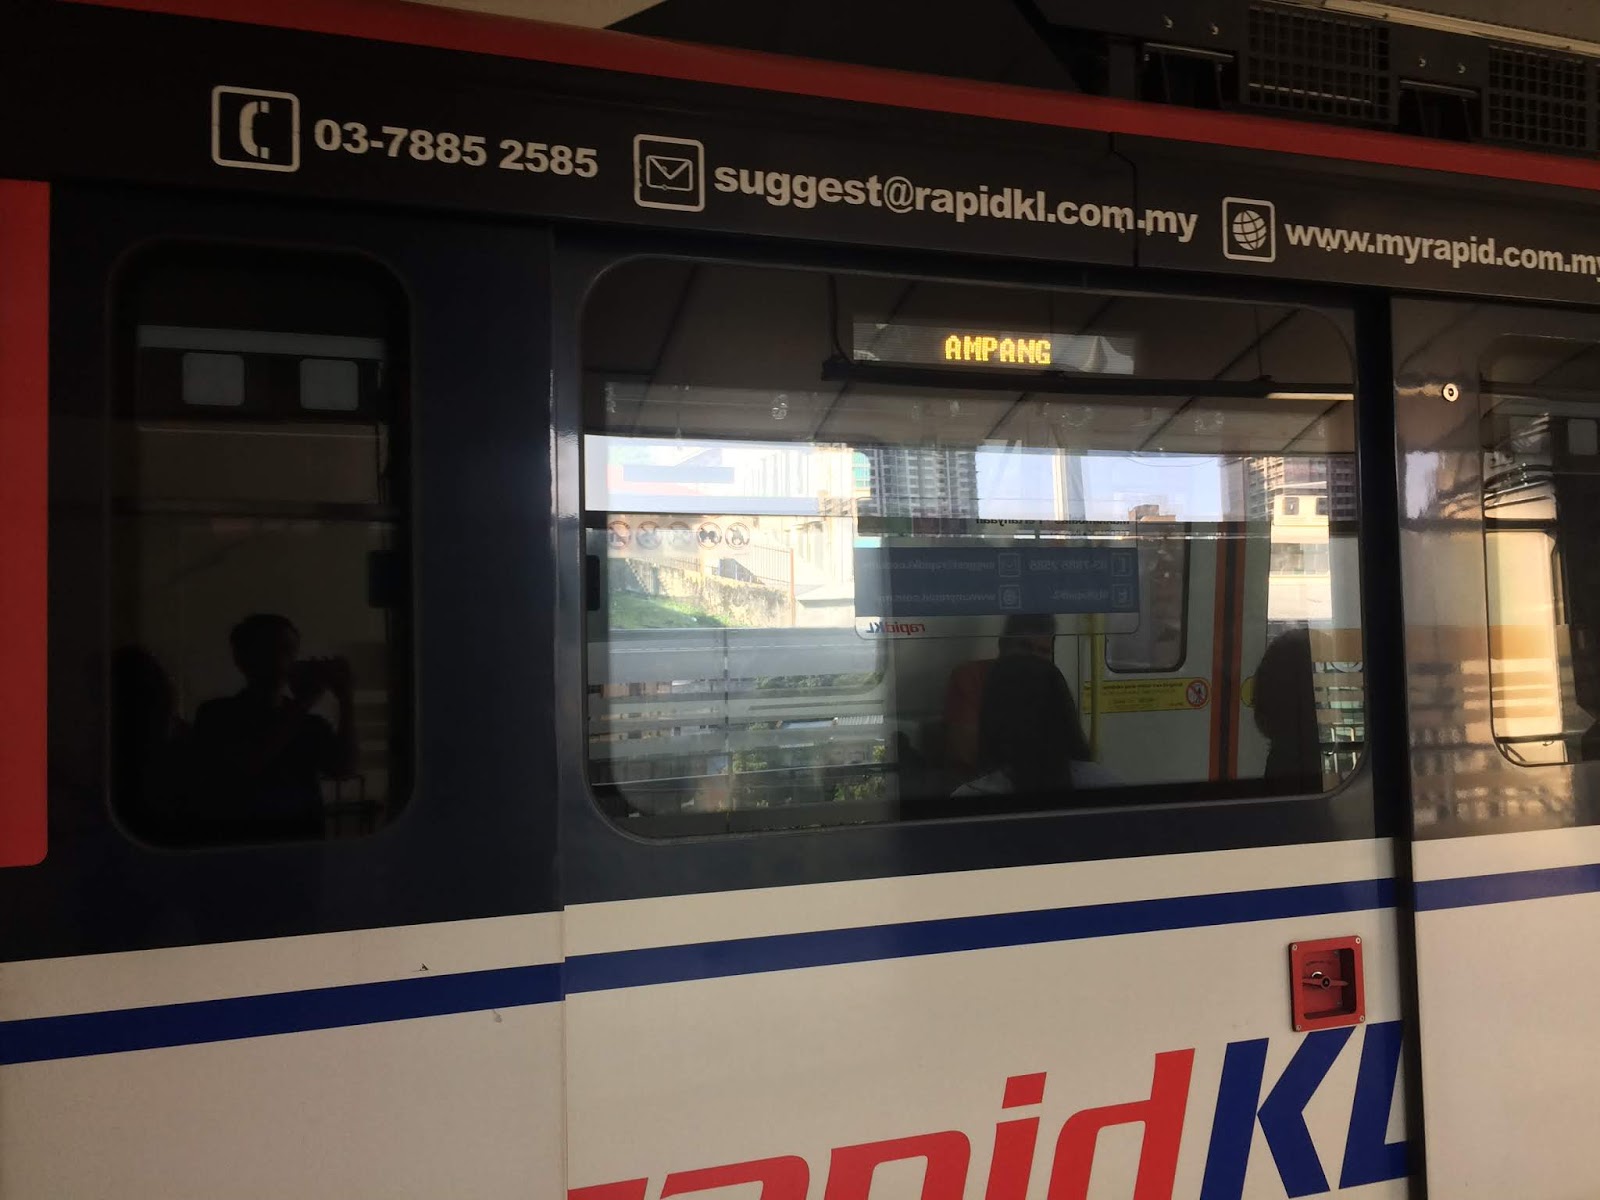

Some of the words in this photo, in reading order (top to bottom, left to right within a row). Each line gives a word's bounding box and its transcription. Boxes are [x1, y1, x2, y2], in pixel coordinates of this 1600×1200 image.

[314, 119, 487, 167] 03-7885
[499, 138, 598, 178] 2585
[714, 165, 1198, 243] suggest@rapidkl.com.my
[1284, 222, 1600, 283] www.myrapid.com.m
[945, 335, 1051, 364] AMPANG
[567, 1020, 1411, 1200] idKL
